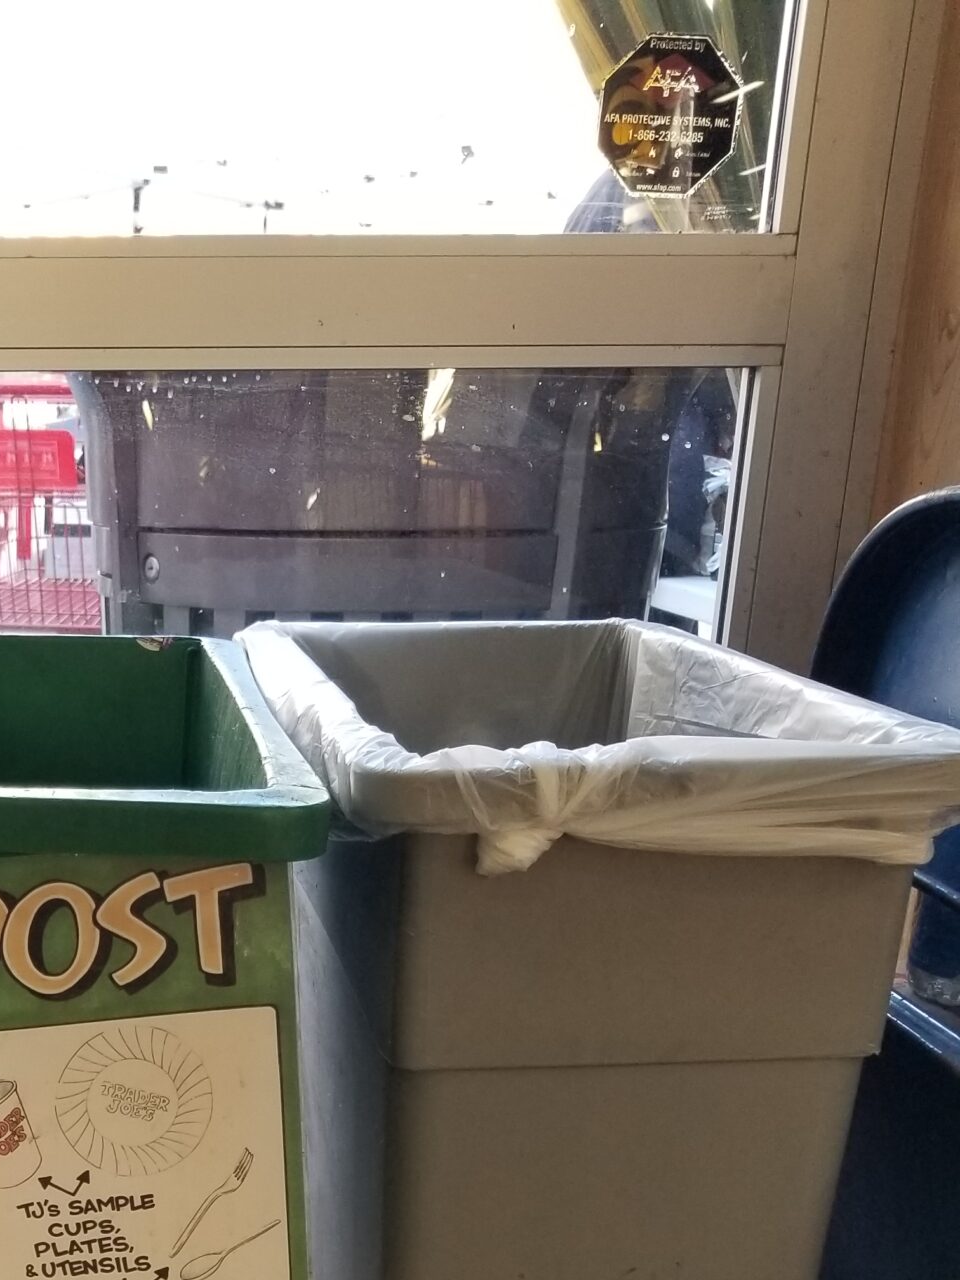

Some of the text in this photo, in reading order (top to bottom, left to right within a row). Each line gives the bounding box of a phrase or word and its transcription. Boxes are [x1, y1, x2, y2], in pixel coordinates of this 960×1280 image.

[649, 38, 707, 54] Protected by
[604, 113, 732, 129] AFA PROTECTIVE SYSTEMS, INC.
[99, 1080, 171, 1112] TRADER
[16, 1193, 156, 1219] TJ's SAMPLE
[47, 1219, 121, 1237] CUPS,
[33, 1236, 135, 1258] PLATES,
[25, 1255, 152, 1278] & UTENSILS
